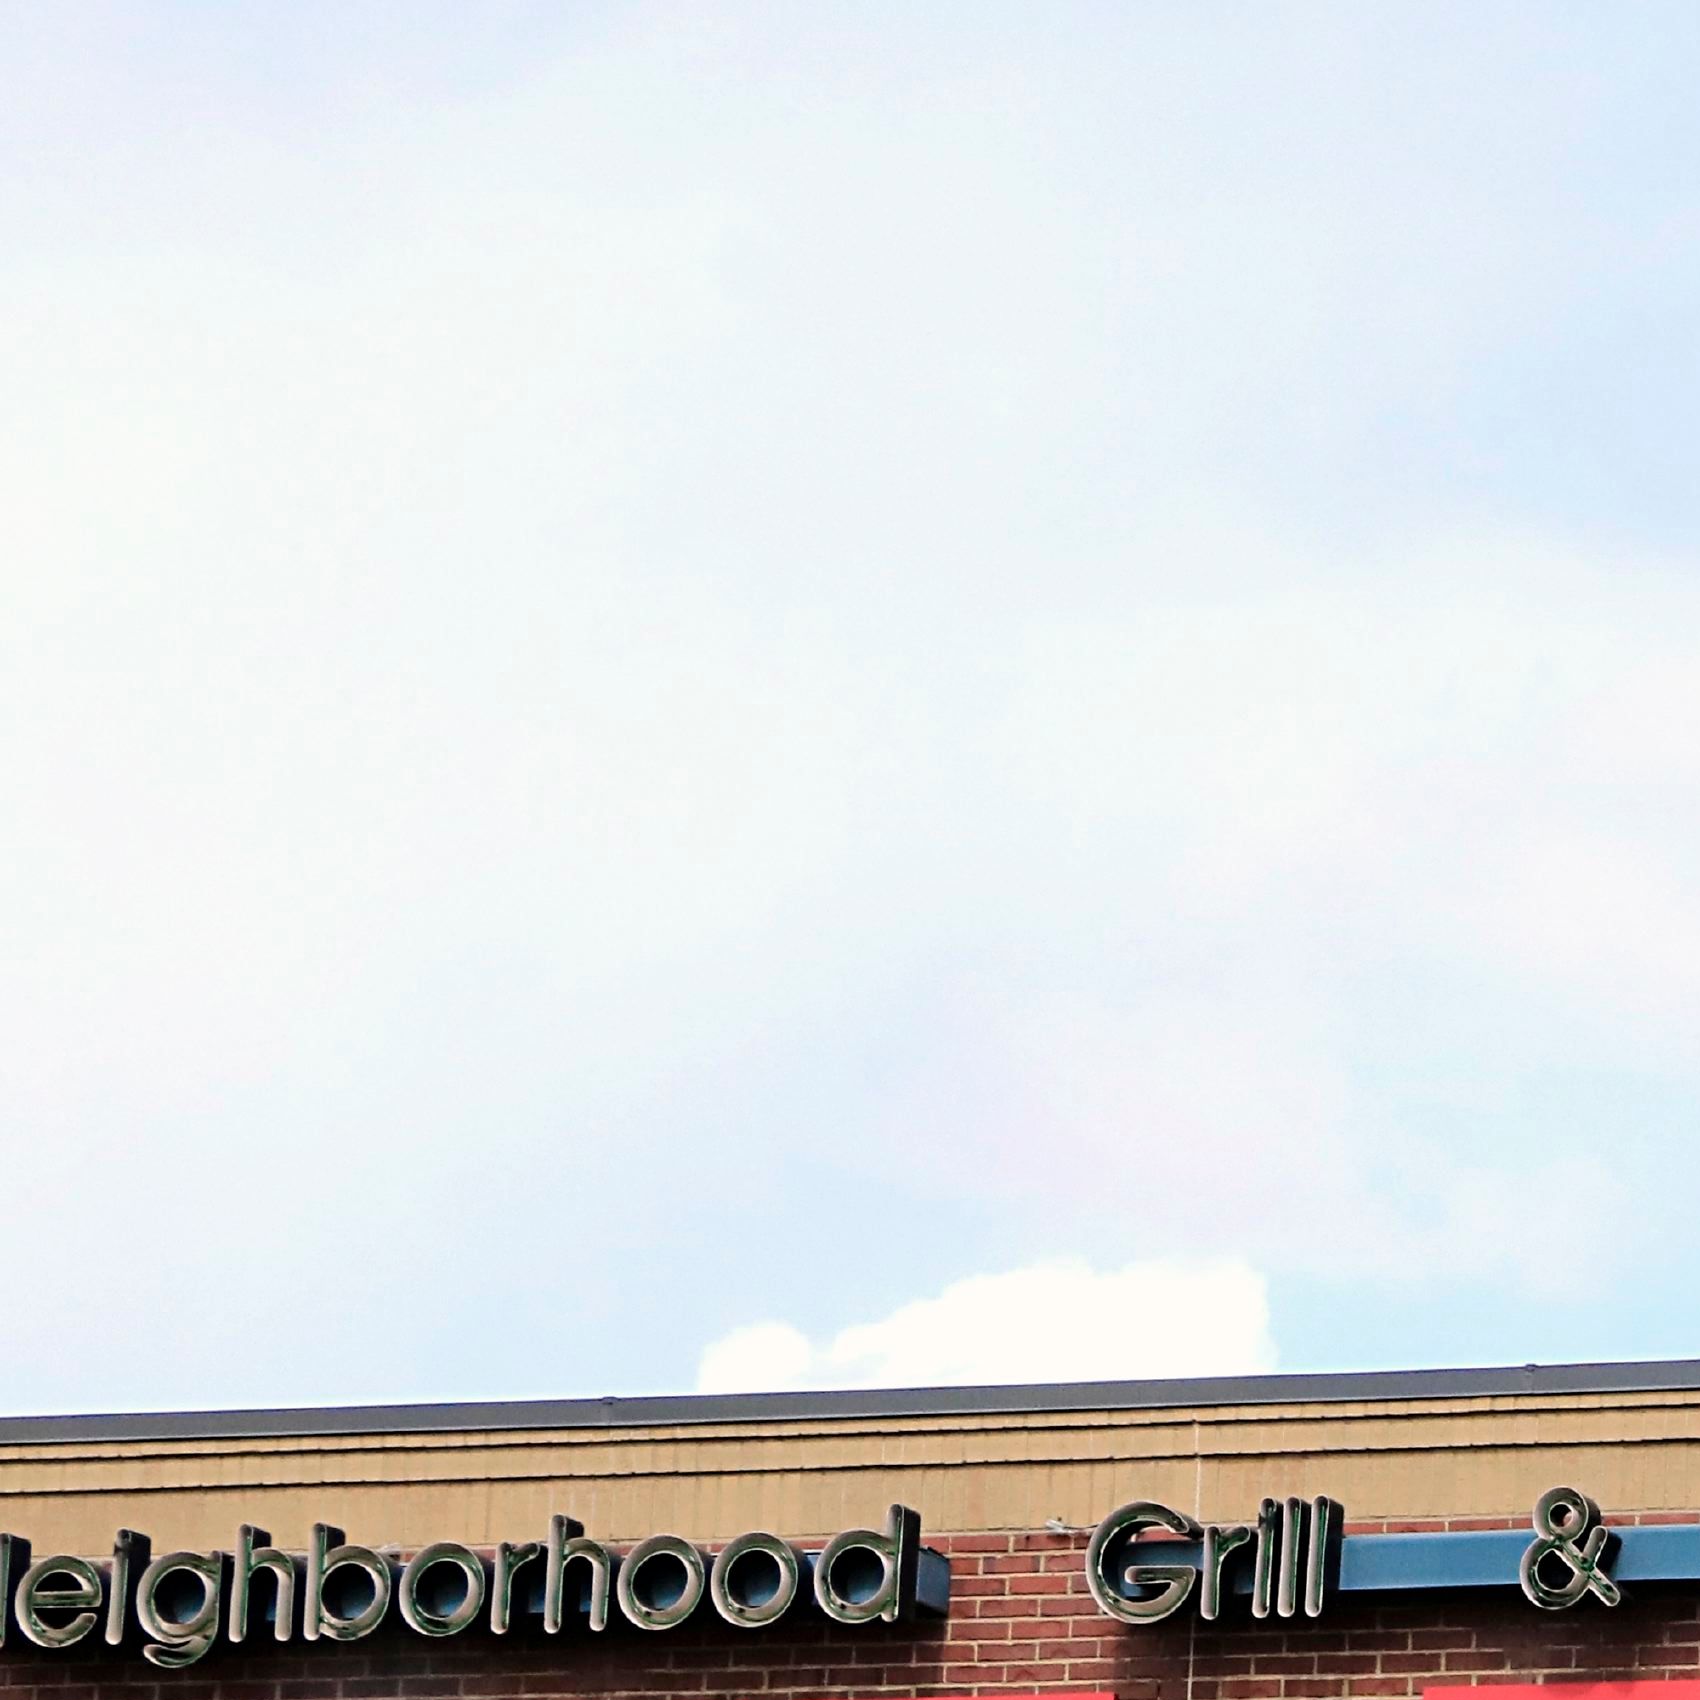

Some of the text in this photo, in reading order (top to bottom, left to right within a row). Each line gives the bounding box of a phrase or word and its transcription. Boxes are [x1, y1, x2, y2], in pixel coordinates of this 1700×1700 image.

[0, 1503, 920, 1667] eighborhood
[1084, 1495, 1342, 1624] Grill
[1524, 1485, 1622, 1610] &
